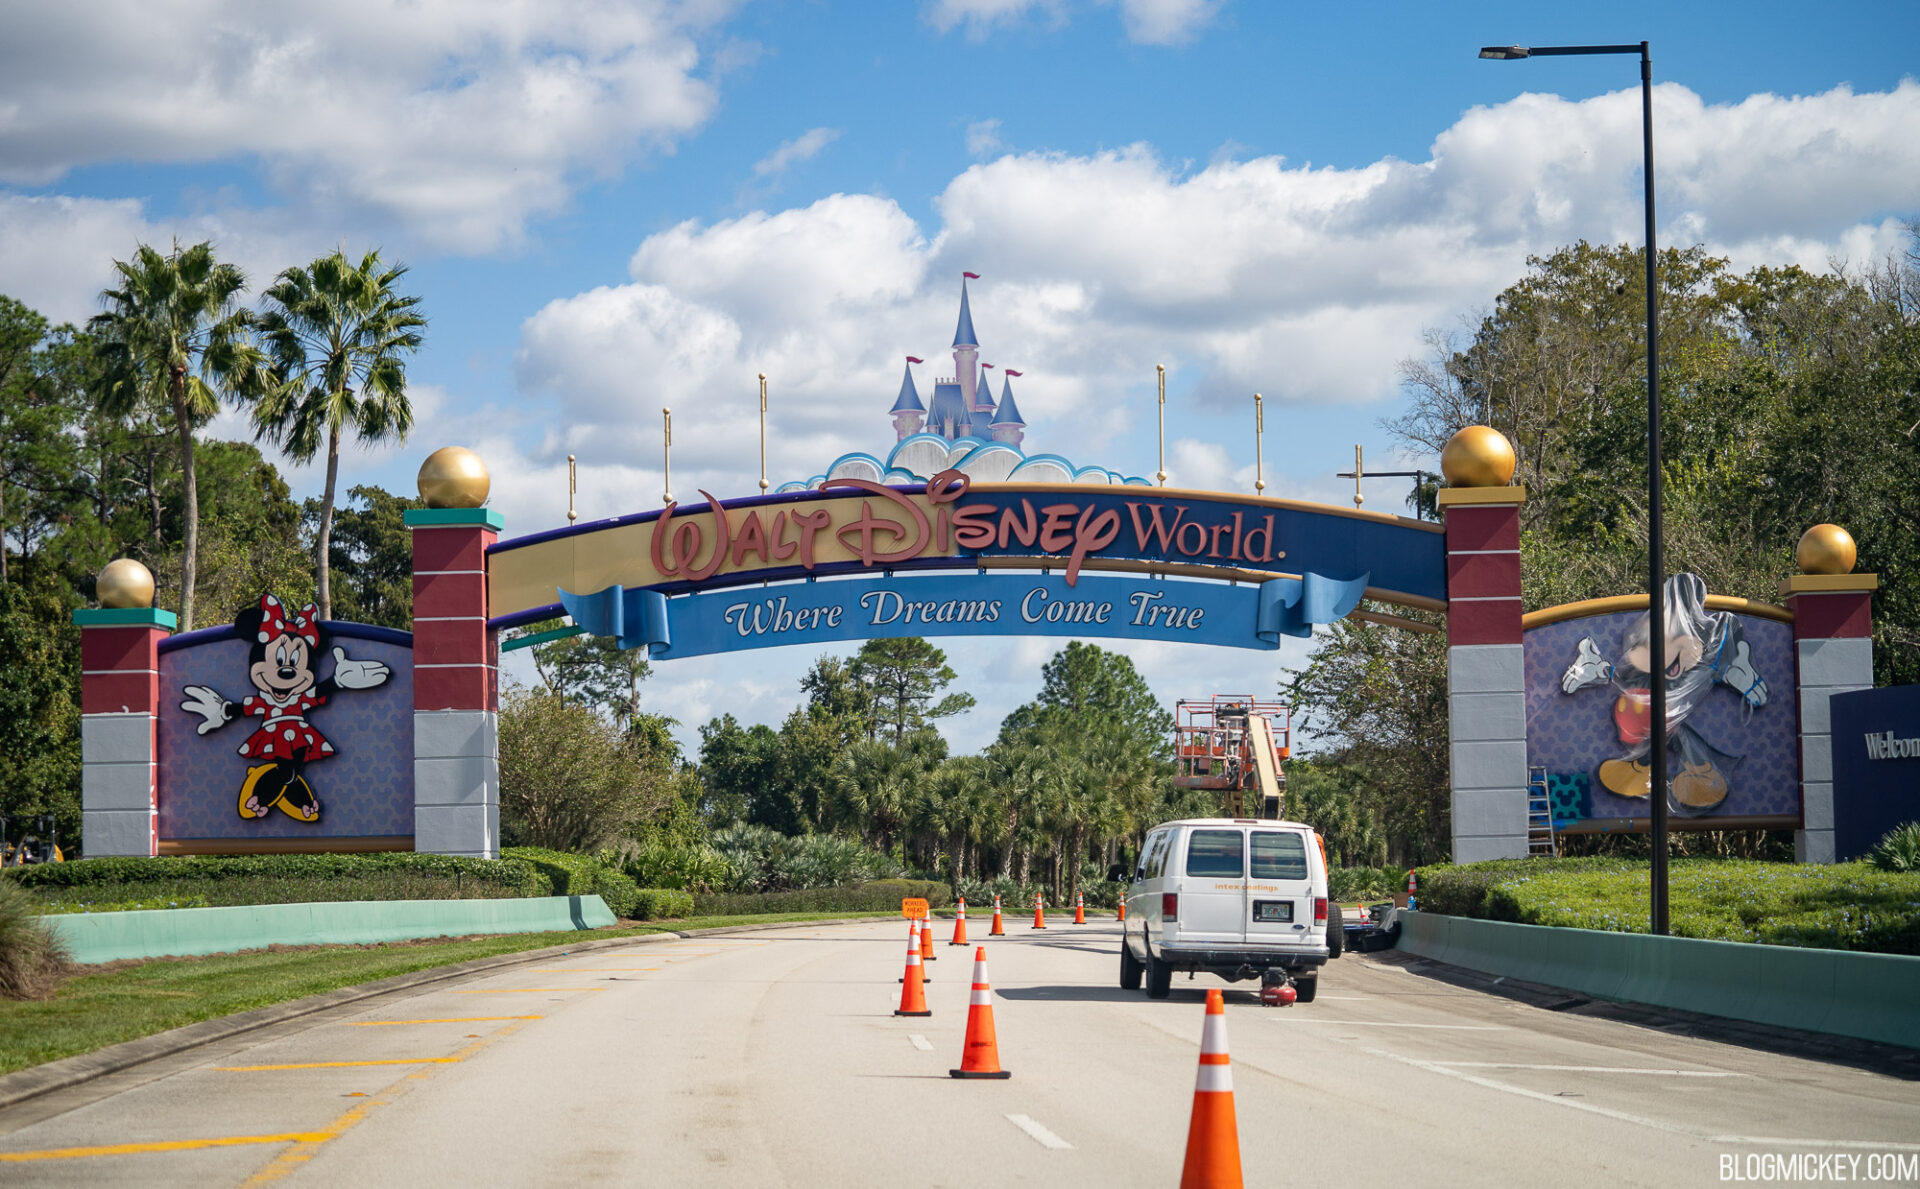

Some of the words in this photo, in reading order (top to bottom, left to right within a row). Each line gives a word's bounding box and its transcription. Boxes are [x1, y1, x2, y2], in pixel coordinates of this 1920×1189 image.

[723, 596, 844, 638] Where
[859, 589, 1003, 627] Dreams
[1020, 587, 1114, 625] Come
[1129, 591, 1205, 630] True
